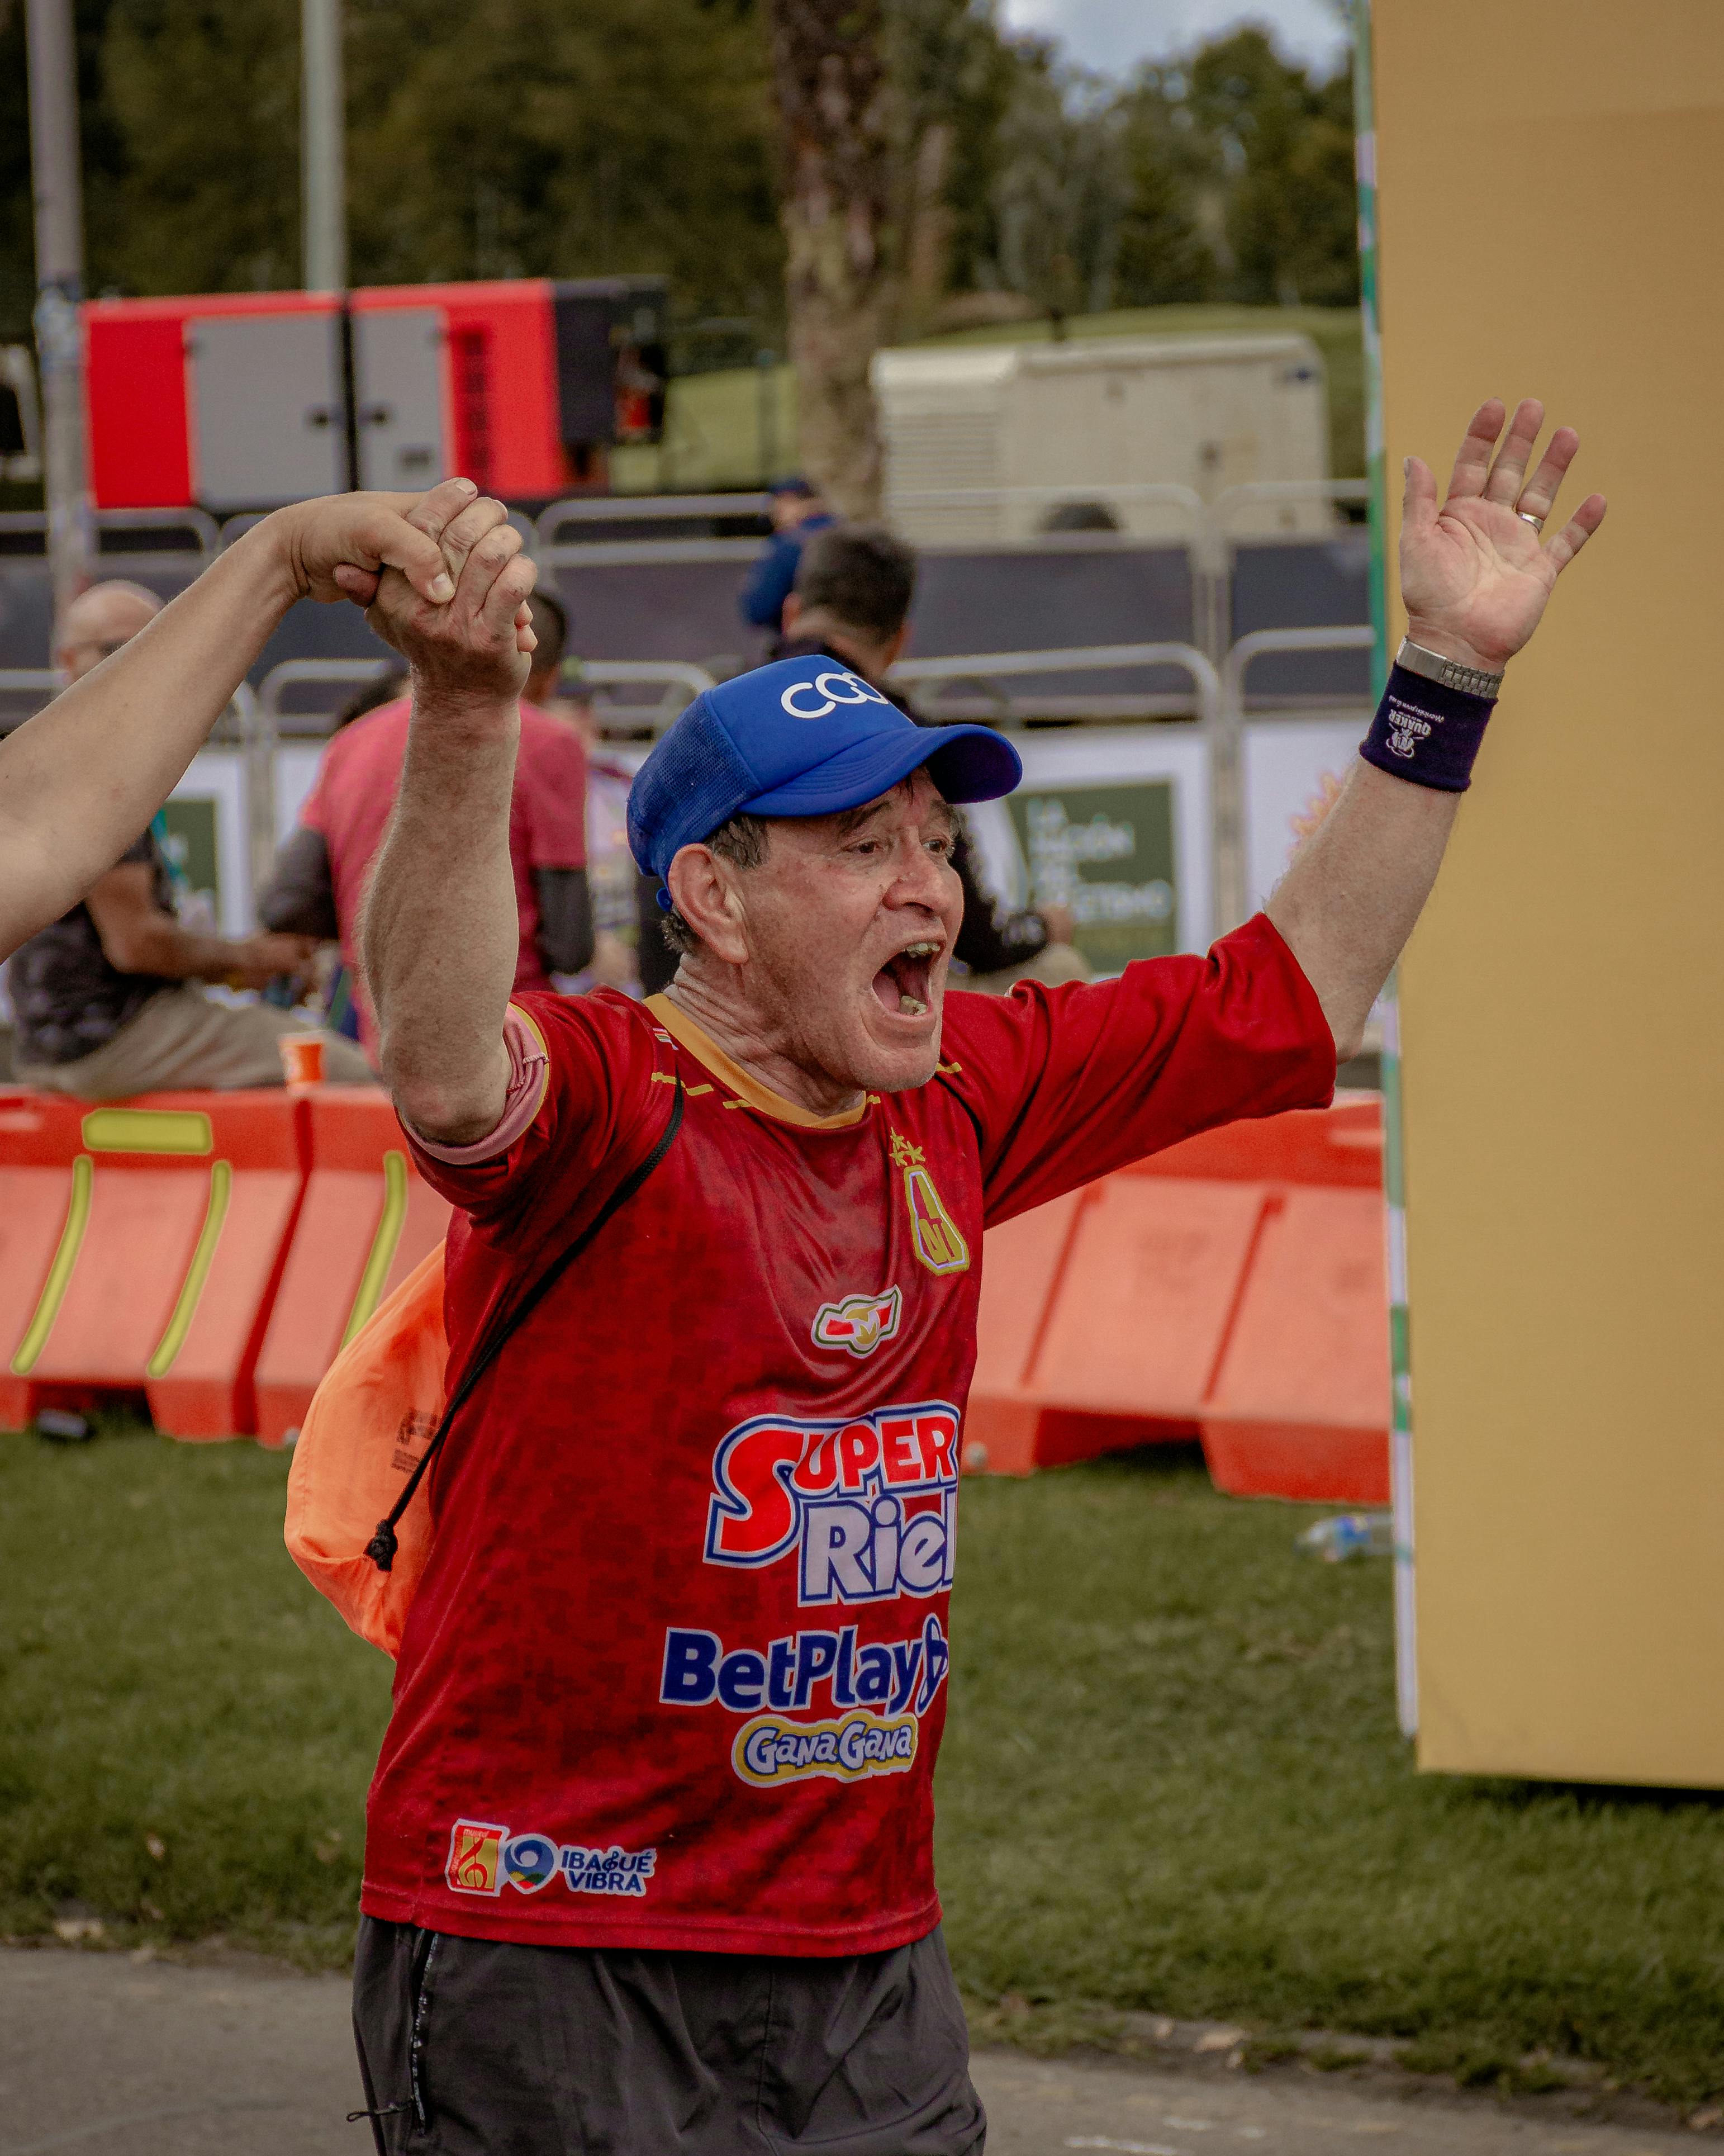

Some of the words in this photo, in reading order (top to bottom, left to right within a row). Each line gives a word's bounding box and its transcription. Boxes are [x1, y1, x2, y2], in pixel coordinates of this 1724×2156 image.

[1389, 709, 1431, 737] QUAKER
[712, 1408, 958, 1560] SUPER
[801, 1491, 956, 1600] Riel
[661, 1627, 924, 1716] BetPlay
[561, 1850, 652, 1873] IBAGUÉ
[568, 1870, 642, 1892] VIBRA
